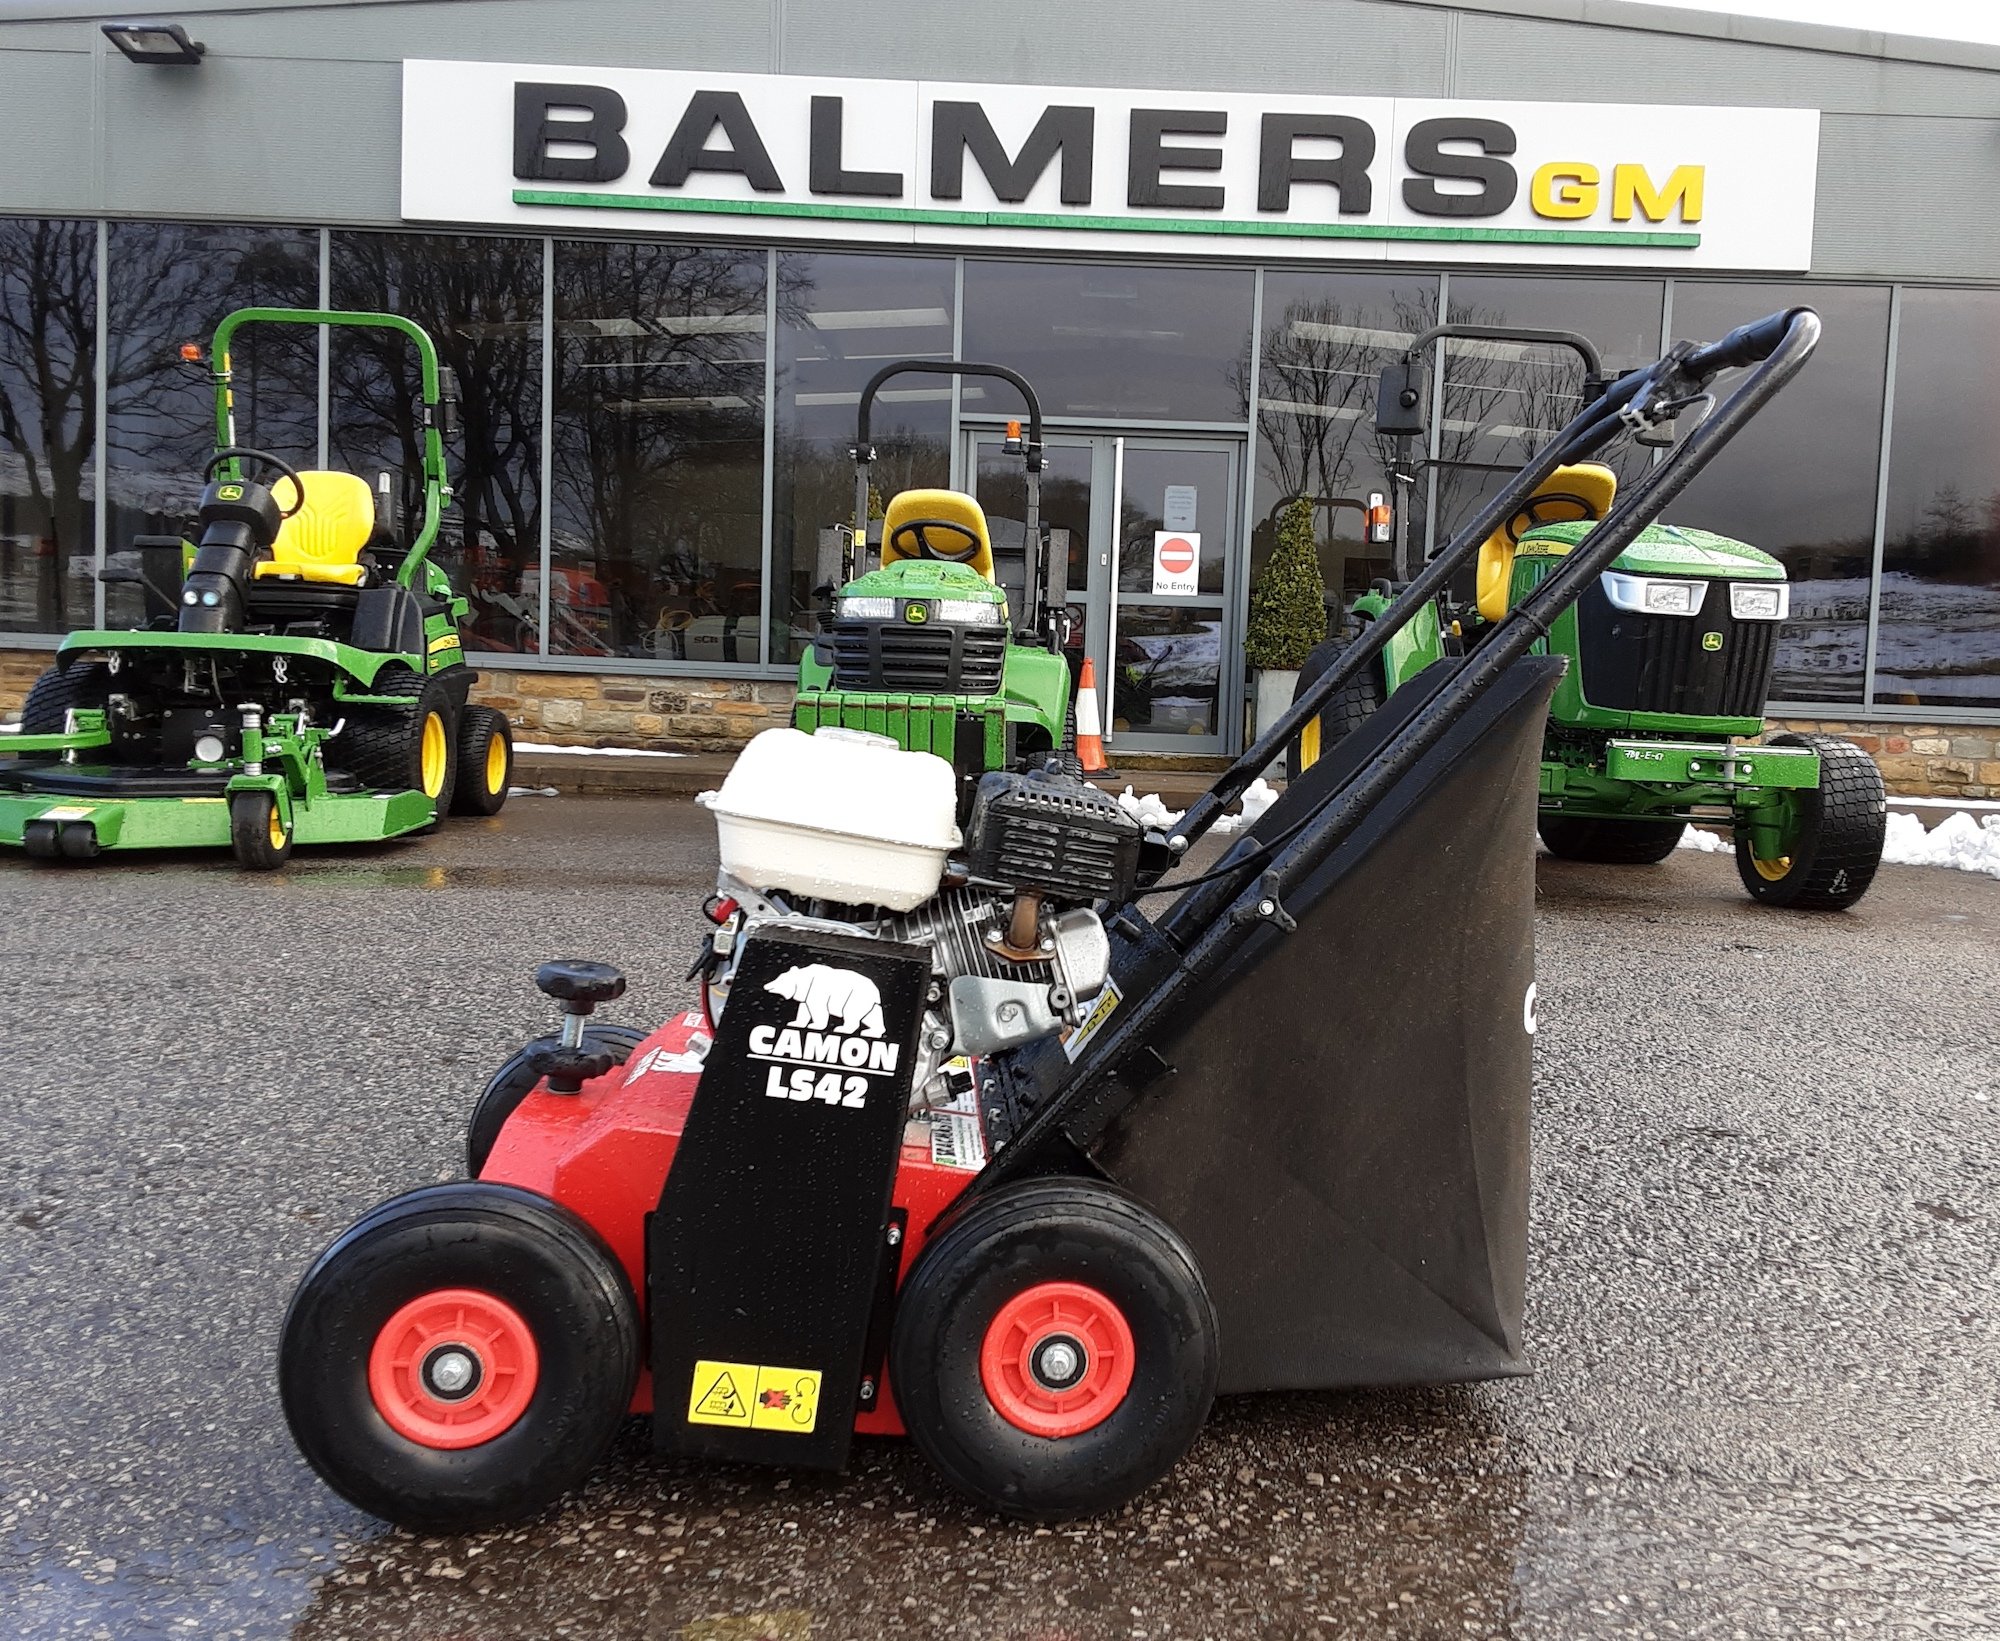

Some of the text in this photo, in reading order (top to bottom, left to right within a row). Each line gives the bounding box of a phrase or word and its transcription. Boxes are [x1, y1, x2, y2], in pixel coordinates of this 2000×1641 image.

[513, 81, 1705, 223] BALMERS GM
[1156, 582, 1195, 592] No Entry
[748, 1024, 900, 1071] CAMON
[765, 1065, 869, 1109] LS42
